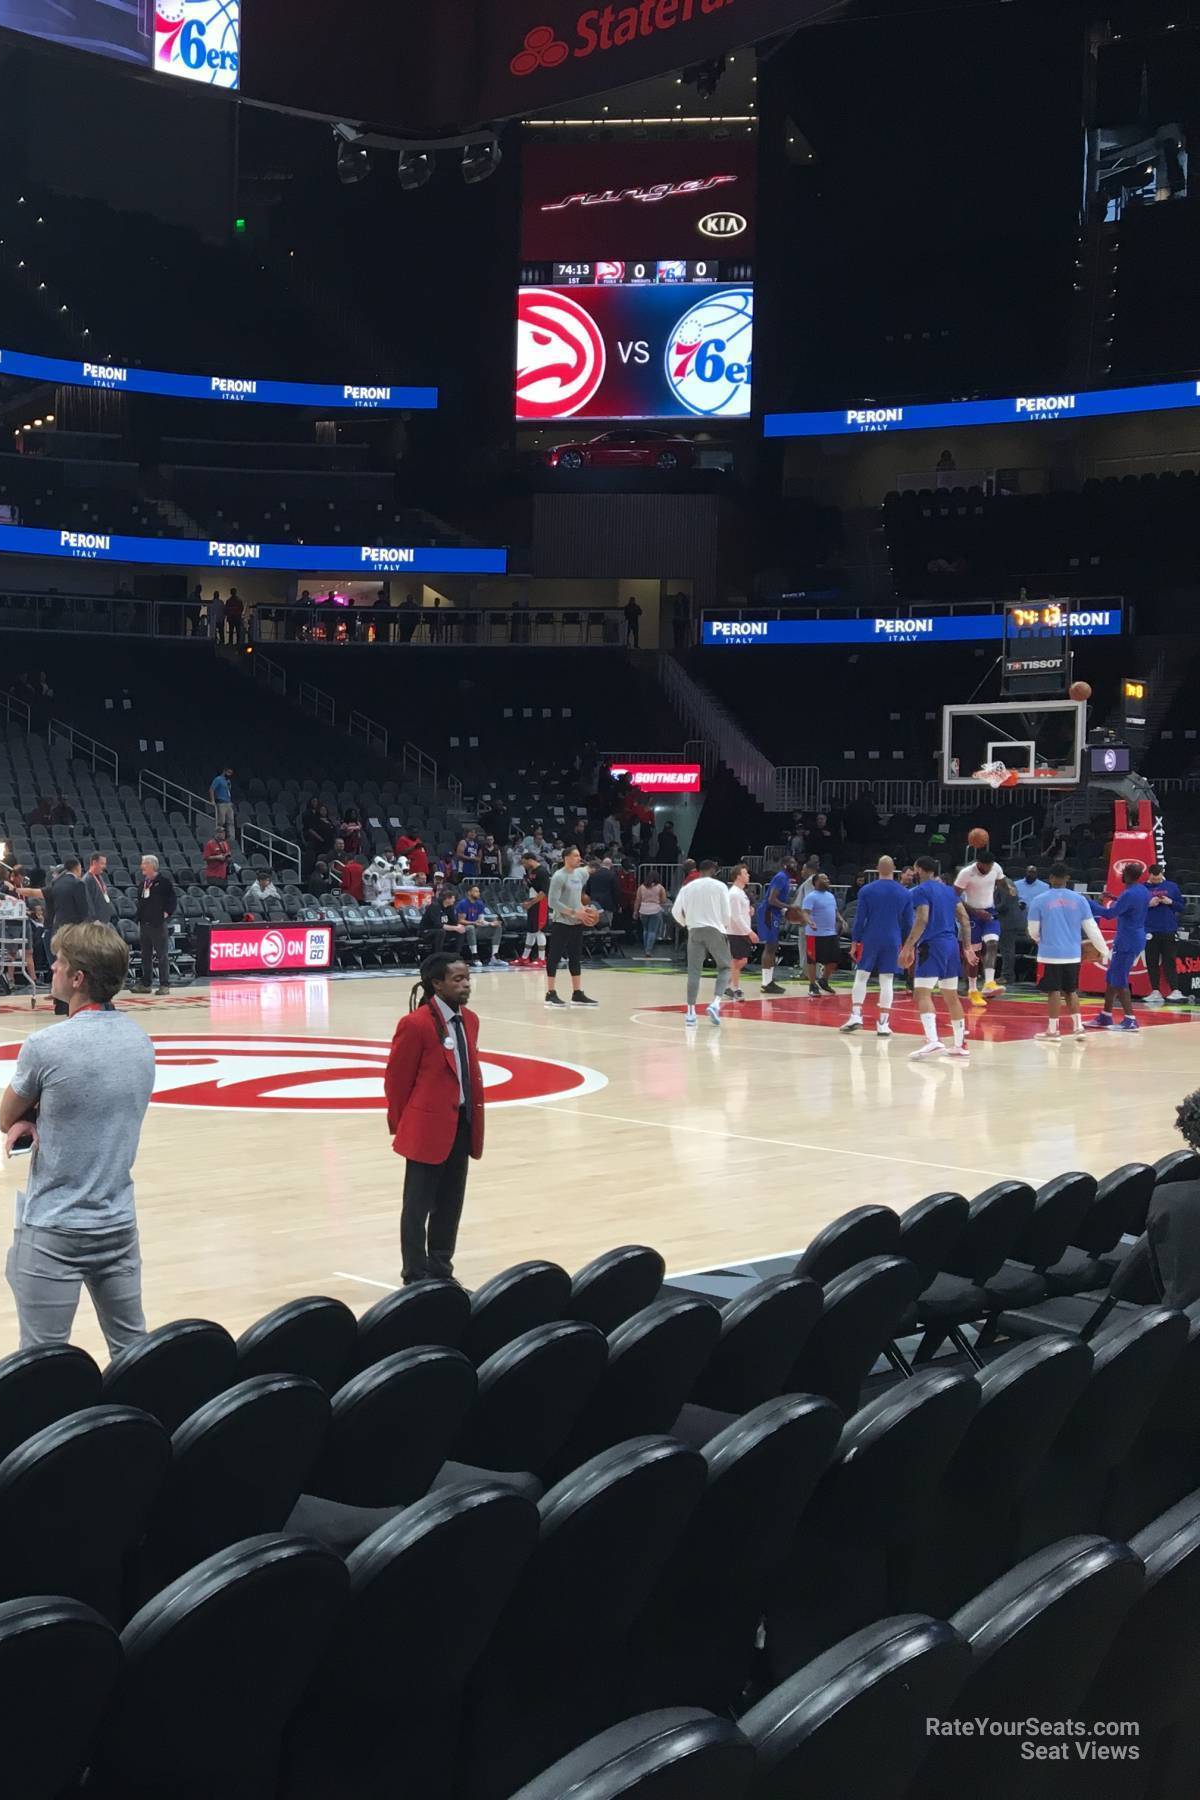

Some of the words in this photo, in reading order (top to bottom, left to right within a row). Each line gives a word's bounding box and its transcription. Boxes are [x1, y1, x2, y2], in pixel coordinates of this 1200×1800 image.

[558, 264, 590, 275] 74:13
[634, 263, 646, 278] 0
[695, 262, 707, 276] 0
[617, 341, 650, 364] VS
[83, 362, 127, 382] PERONI
[211, 377, 257, 394] PERONI
[343, 385, 391, 400] PERONI
[1015, 395, 1075, 413] PERONI
[846, 408, 903, 424] PERONI
[1029, 411, 1061, 421] ITALY
[860, 424, 888, 432] ITALY
[60, 531, 110, 550] PERONI
[72, 548, 98, 559] ITALY
[209, 541, 260, 559] PERONI
[361, 546, 414, 562] PERONI
[221, 559, 247, 567] ITALY
[374, 563, 401, 571] ITALY
[712, 621, 768, 636] PERONI
[875, 618, 933, 633] PERONI
[888, 634, 917, 642] ITALY
[1022, 659, 1063, 669] TISSOT
[634, 772, 698, 784] SOUTHEAST
[310, 935, 325, 945] FOX
[210, 942, 259, 959] STREAM
[287, 941, 303, 956] ON
[309, 950, 324, 960] GO
